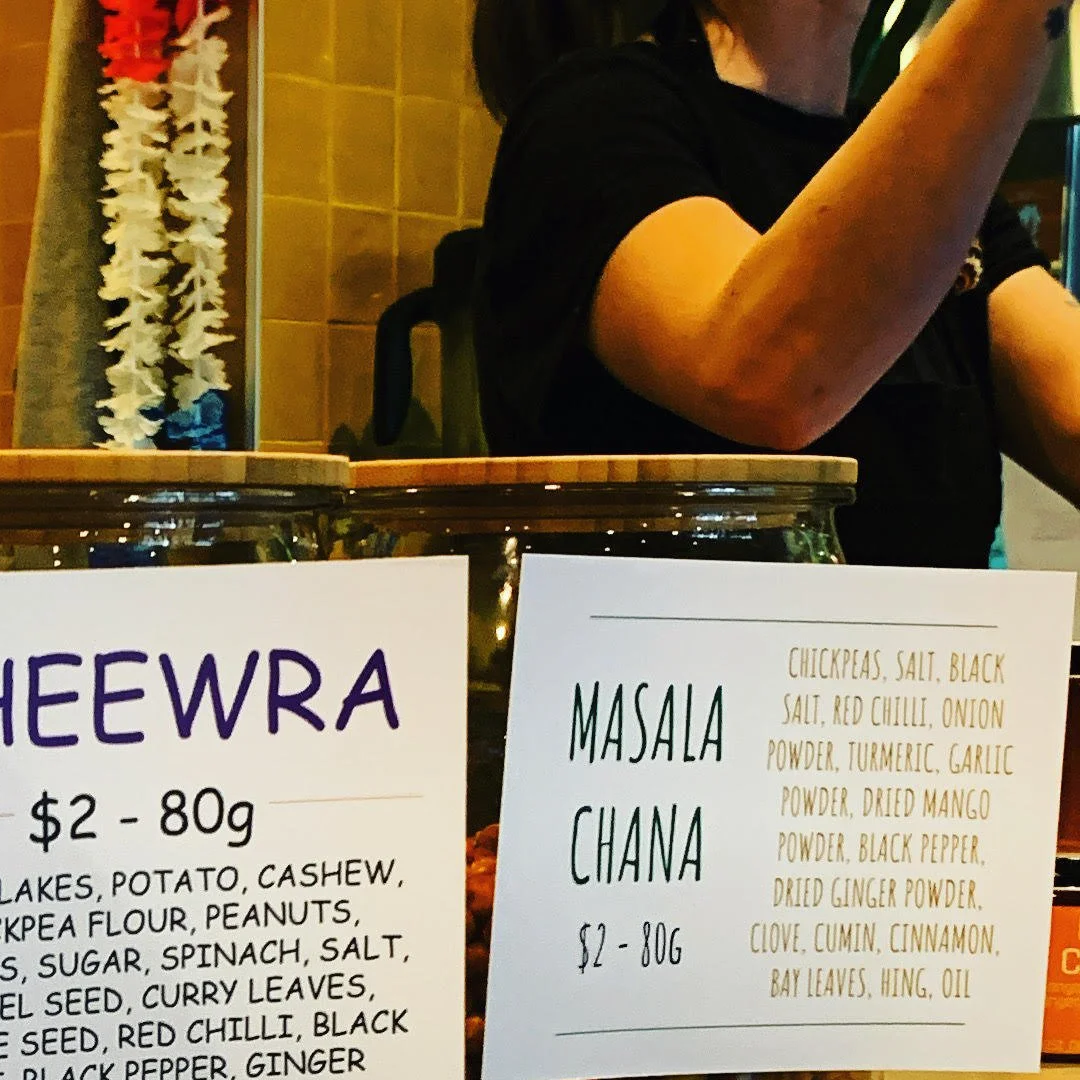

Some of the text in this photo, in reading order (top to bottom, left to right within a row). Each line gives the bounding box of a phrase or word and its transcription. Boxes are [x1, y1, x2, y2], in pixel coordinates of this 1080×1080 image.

[789, 647, 1004, 683] CHICKPEAS, SALT, BLACK
[570, 681, 722, 763] MASALA
[782, 693, 1004, 729] SALT, RED CHILLI, ONION
[767, 739, 1013, 775] POWDER, TURMERIC, GARLIC
[29, 789, 97, 853] $2
[160, 787, 254, 848] 80g
[782, 786, 990, 820] POWDER, DRIED MANGO
[571, 803, 702, 885] CHANA
[778, 832, 984, 865] POWDER, BLACK PEPPER,
[112, 866, 247, 897] POTATO,
[258, 859, 403, 889] CASHEW,
[774, 877, 982, 910] DRIED GINGER POWDER,
[89, 907, 196, 938] FLOUR,
[206, 899, 359, 930] PEANUTS,
[38, 948, 150, 978] SUGAR,
[161, 938, 309, 971] SPINACH,
[320, 935, 409, 963] SALT,
[578, 923, 605, 974] $2
[641, 921, 681, 967] 80G
[751, 923, 999, 955] CLOVE, CUMIN, CINNAMON,
[44, 987, 131, 1016] SEED,
[142, 979, 237, 1009] CURRY
[249, 973, 374, 1004] LEAVES,
[771, 968, 970, 999] BAY LEAVES, HING, OIL
[21, 1026, 108, 1056] SEED,
[119, 1021, 176, 1049] RED
[187, 1014, 302, 1044] CHILLI,
[314, 1008, 408, 1037] BLACK
[246, 1047, 366, 1078] GINGER
